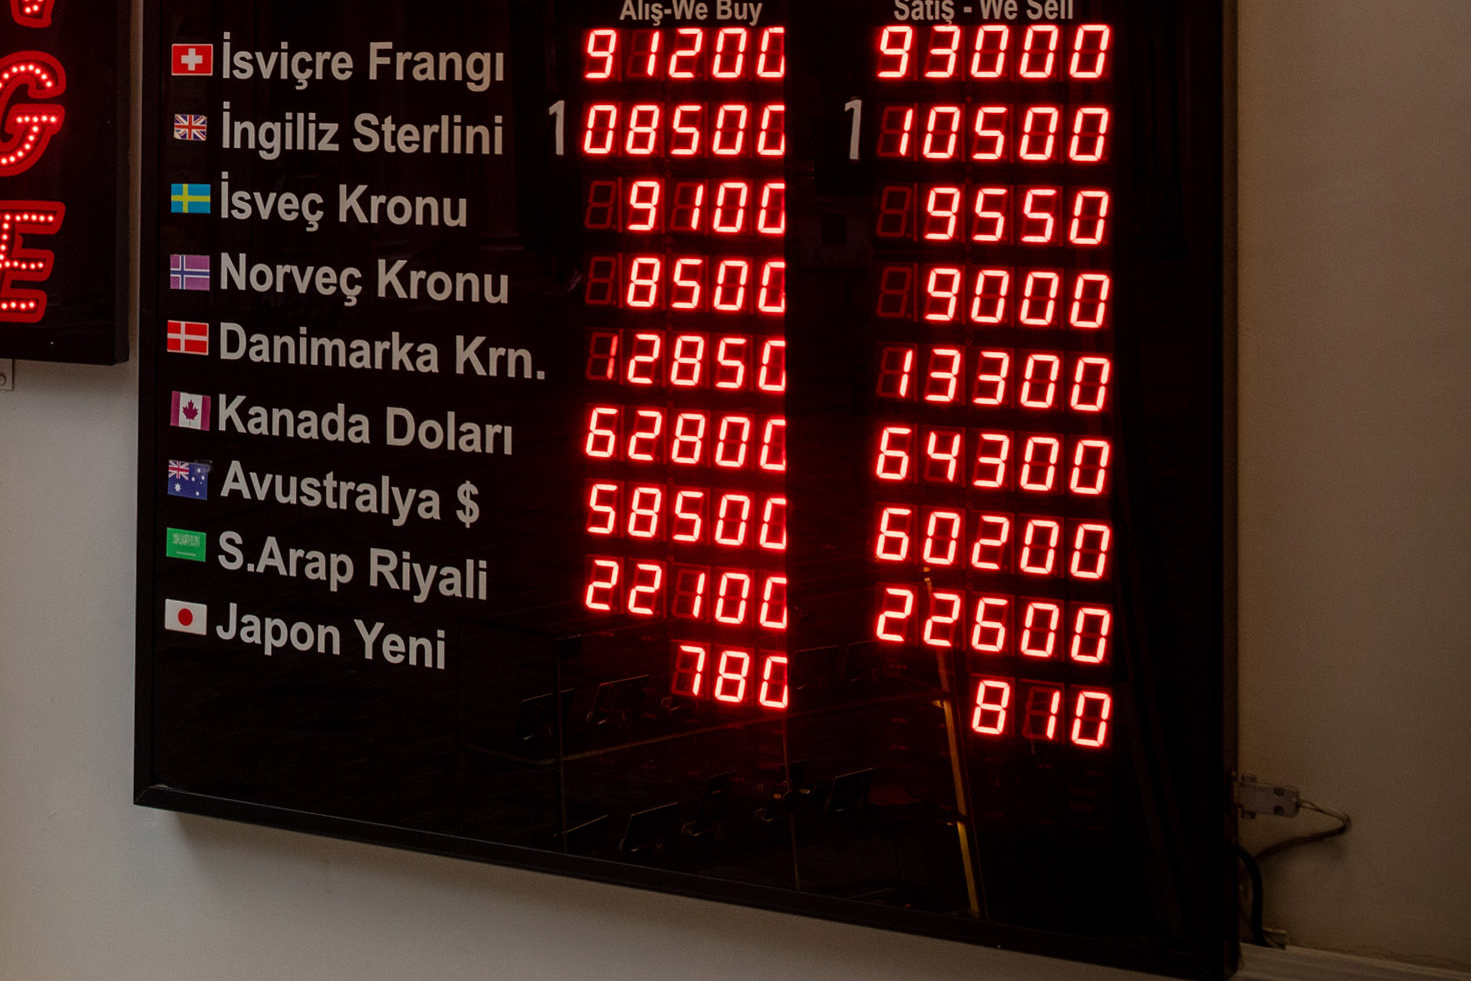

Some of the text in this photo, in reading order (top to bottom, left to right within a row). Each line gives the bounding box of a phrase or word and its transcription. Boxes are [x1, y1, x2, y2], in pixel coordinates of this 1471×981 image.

[222, 32, 504, 91] İsviçre Frangı
[586, 24, 784, 78] 91200
[878, 24, 1110, 79] 93000
[223, 102, 502, 160] İngiliz Sterlini
[221, 173, 466, 229] İsveç Kronu
[629, 181, 784, 233] 9100
[926, 188, 1108, 244] 9550
[221, 253, 507, 305] Norveç Kronu
[627, 258, 785, 312] 8500
[927, 269, 1109, 327] 9000
[221, 322, 546, 381] Danimarka Krn.
[608, 334, 785, 391] 12850
[900, 349, 1109, 411] 13300
[219, 394, 511, 454] Kanada Doları
[586, 408, 785, 470] 62800
[877, 428, 1109, 494] 64300
[221, 461, 479, 528] Avustralya $
[588, 484, 786, 549] 58500
[219, 531, 486, 602] S.Arap Riyali
[877, 508, 1109, 578] 60200
[586, 560, 787, 628] 22100
[216, 603, 444, 669] Japon Yeni
[877, 589, 1109, 662] 22600
[681, 646, 787, 708] 780
[973, 681, 1110, 746] 810
